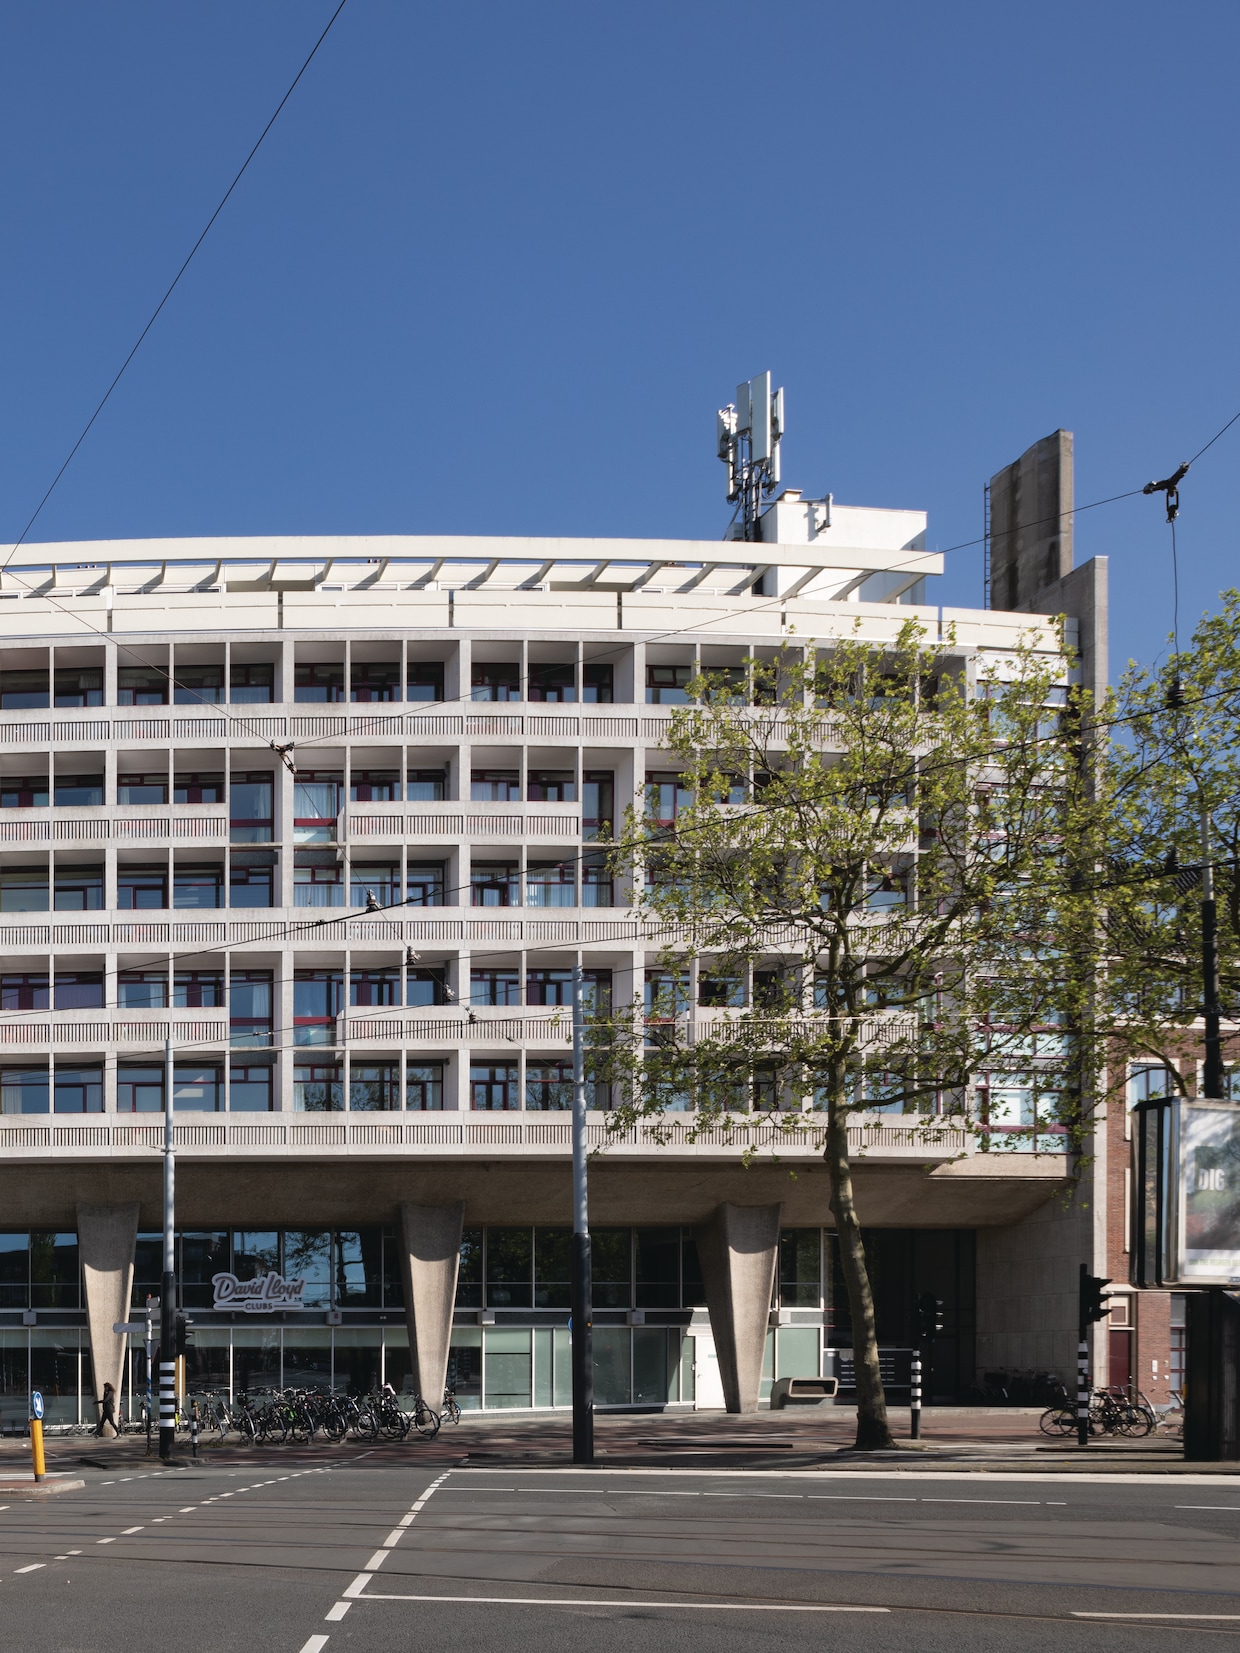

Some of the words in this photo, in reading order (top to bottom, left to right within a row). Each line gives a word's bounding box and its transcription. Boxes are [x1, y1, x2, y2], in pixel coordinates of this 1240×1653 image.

[1198, 1168, 1225, 1191] DIG
[215, 1275, 265, 1300] David
[265, 1274, 305, 1300] Lloyd
[245, 1302, 273, 1310] CLUBS
